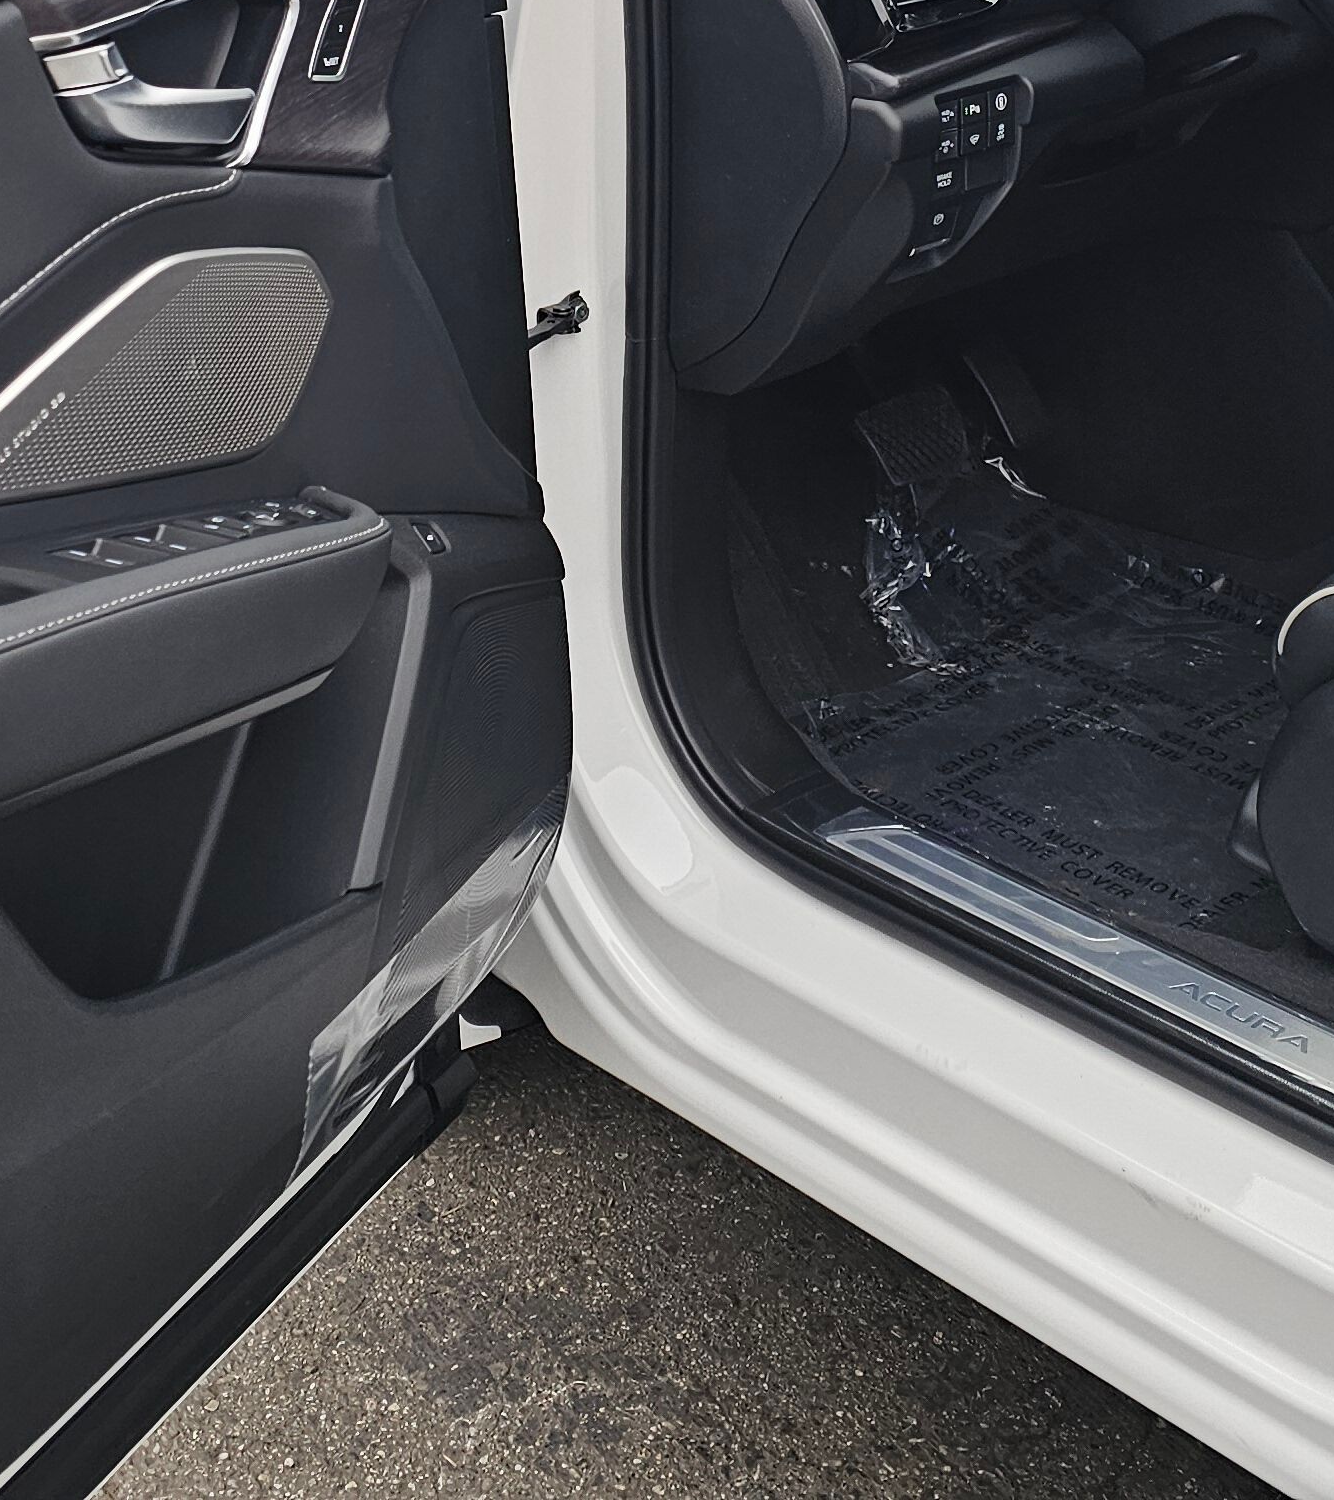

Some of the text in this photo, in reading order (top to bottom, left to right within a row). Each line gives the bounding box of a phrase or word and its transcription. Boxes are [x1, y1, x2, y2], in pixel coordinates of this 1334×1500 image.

[13, 408, 49, 449] STUDIO
[1041, 828, 1104, 861] MUST
[1105, 860, 1202, 910] REMOVE
[1060, 860, 1135, 900] COVER
[1168, 982, 1309, 1054] ACURA
